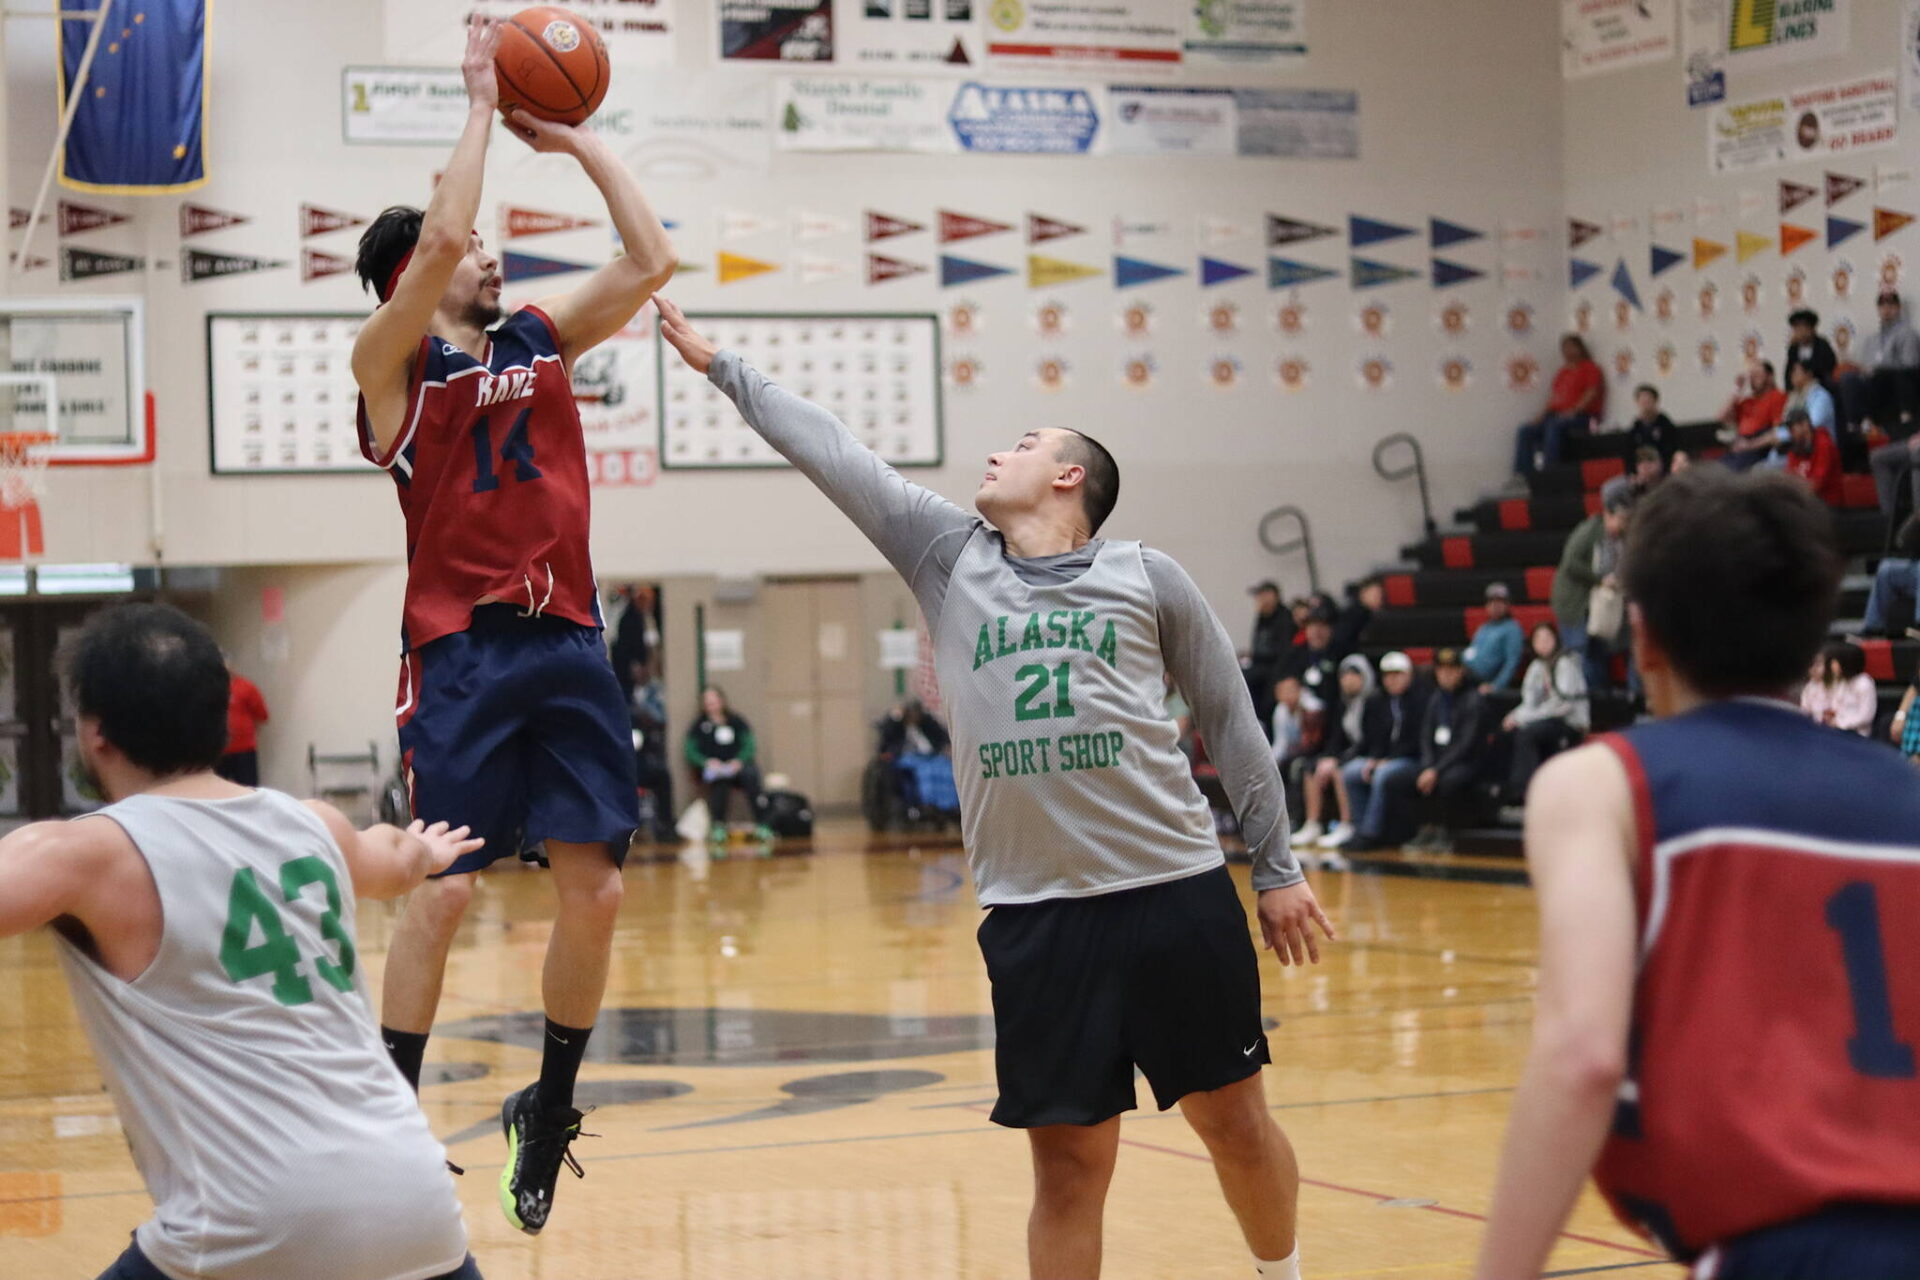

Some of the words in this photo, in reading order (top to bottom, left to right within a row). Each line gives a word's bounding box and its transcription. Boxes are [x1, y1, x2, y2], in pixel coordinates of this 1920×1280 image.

[475, 371, 537, 407] KAKE
[471, 407, 543, 493] 14
[973, 610, 1117, 672] ALASKA
[1015, 661, 1075, 721] 21
[979, 737, 1050, 779] SPORT
[1058, 731, 1124, 771] SHOP
[219, 856, 355, 1006] 43
[1824, 881, 1916, 1079] 1
